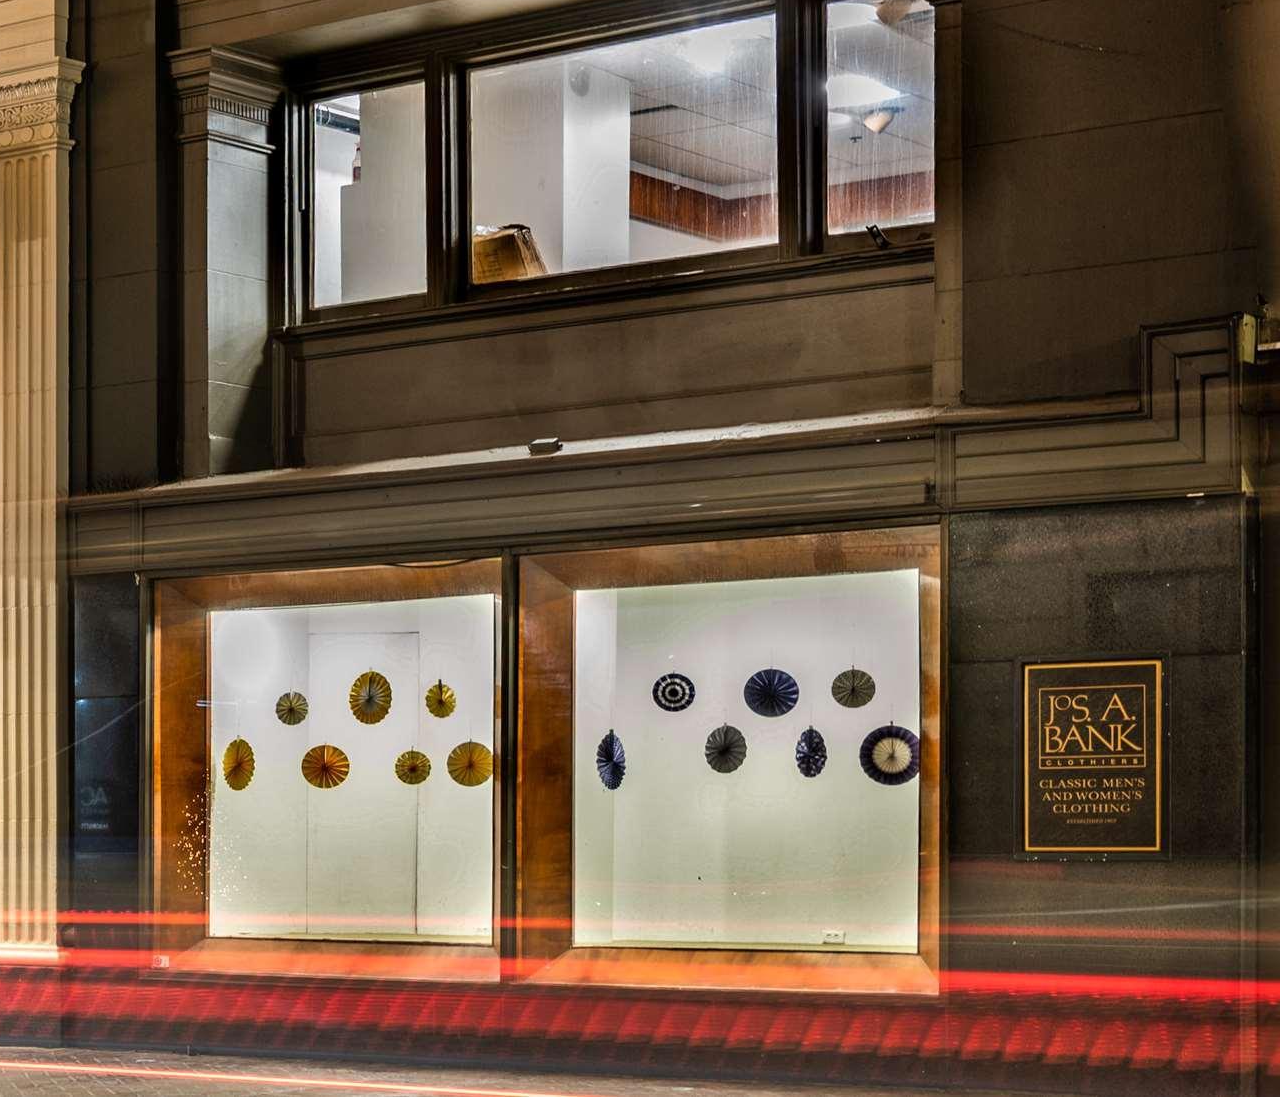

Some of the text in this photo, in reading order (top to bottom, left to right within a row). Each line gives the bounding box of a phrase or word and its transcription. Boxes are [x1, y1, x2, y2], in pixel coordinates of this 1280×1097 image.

[1100, 693, 1137, 722] A.
[1043, 723, 1143, 753] BANK
[1045, 757, 1139, 767] CLOTHIERS
[1039, 777, 1146, 790] CLASSIC MEN'S
[1041, 790, 1143, 802] AND WOMEN'S
[1052, 803, 1131, 814] CLOTHING
